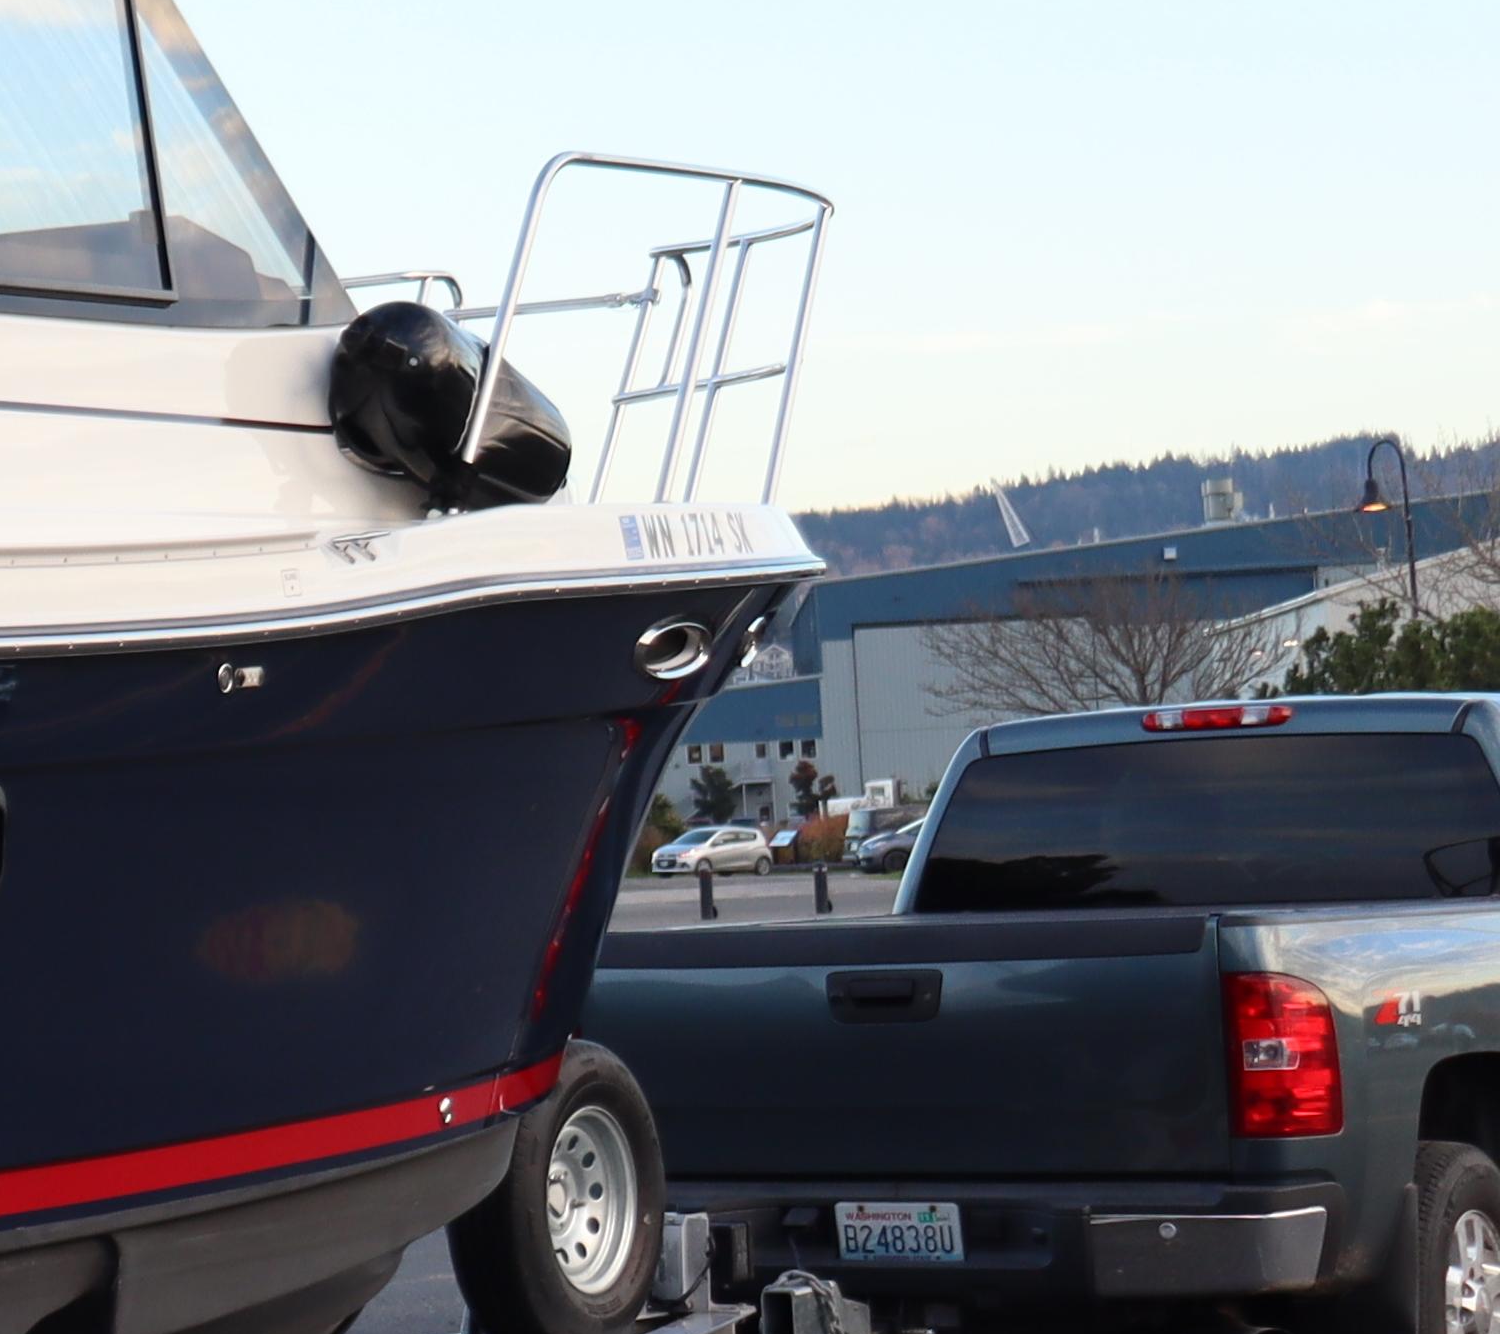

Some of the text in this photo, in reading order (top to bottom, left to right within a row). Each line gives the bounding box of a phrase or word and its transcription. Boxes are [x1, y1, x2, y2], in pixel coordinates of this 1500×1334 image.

[641, 514, 676, 559] WN
[680, 512, 725, 557] 1714
[845, 1211, 912, 1222] WASHINGTON
[844, 1224, 954, 1254] B24838U
